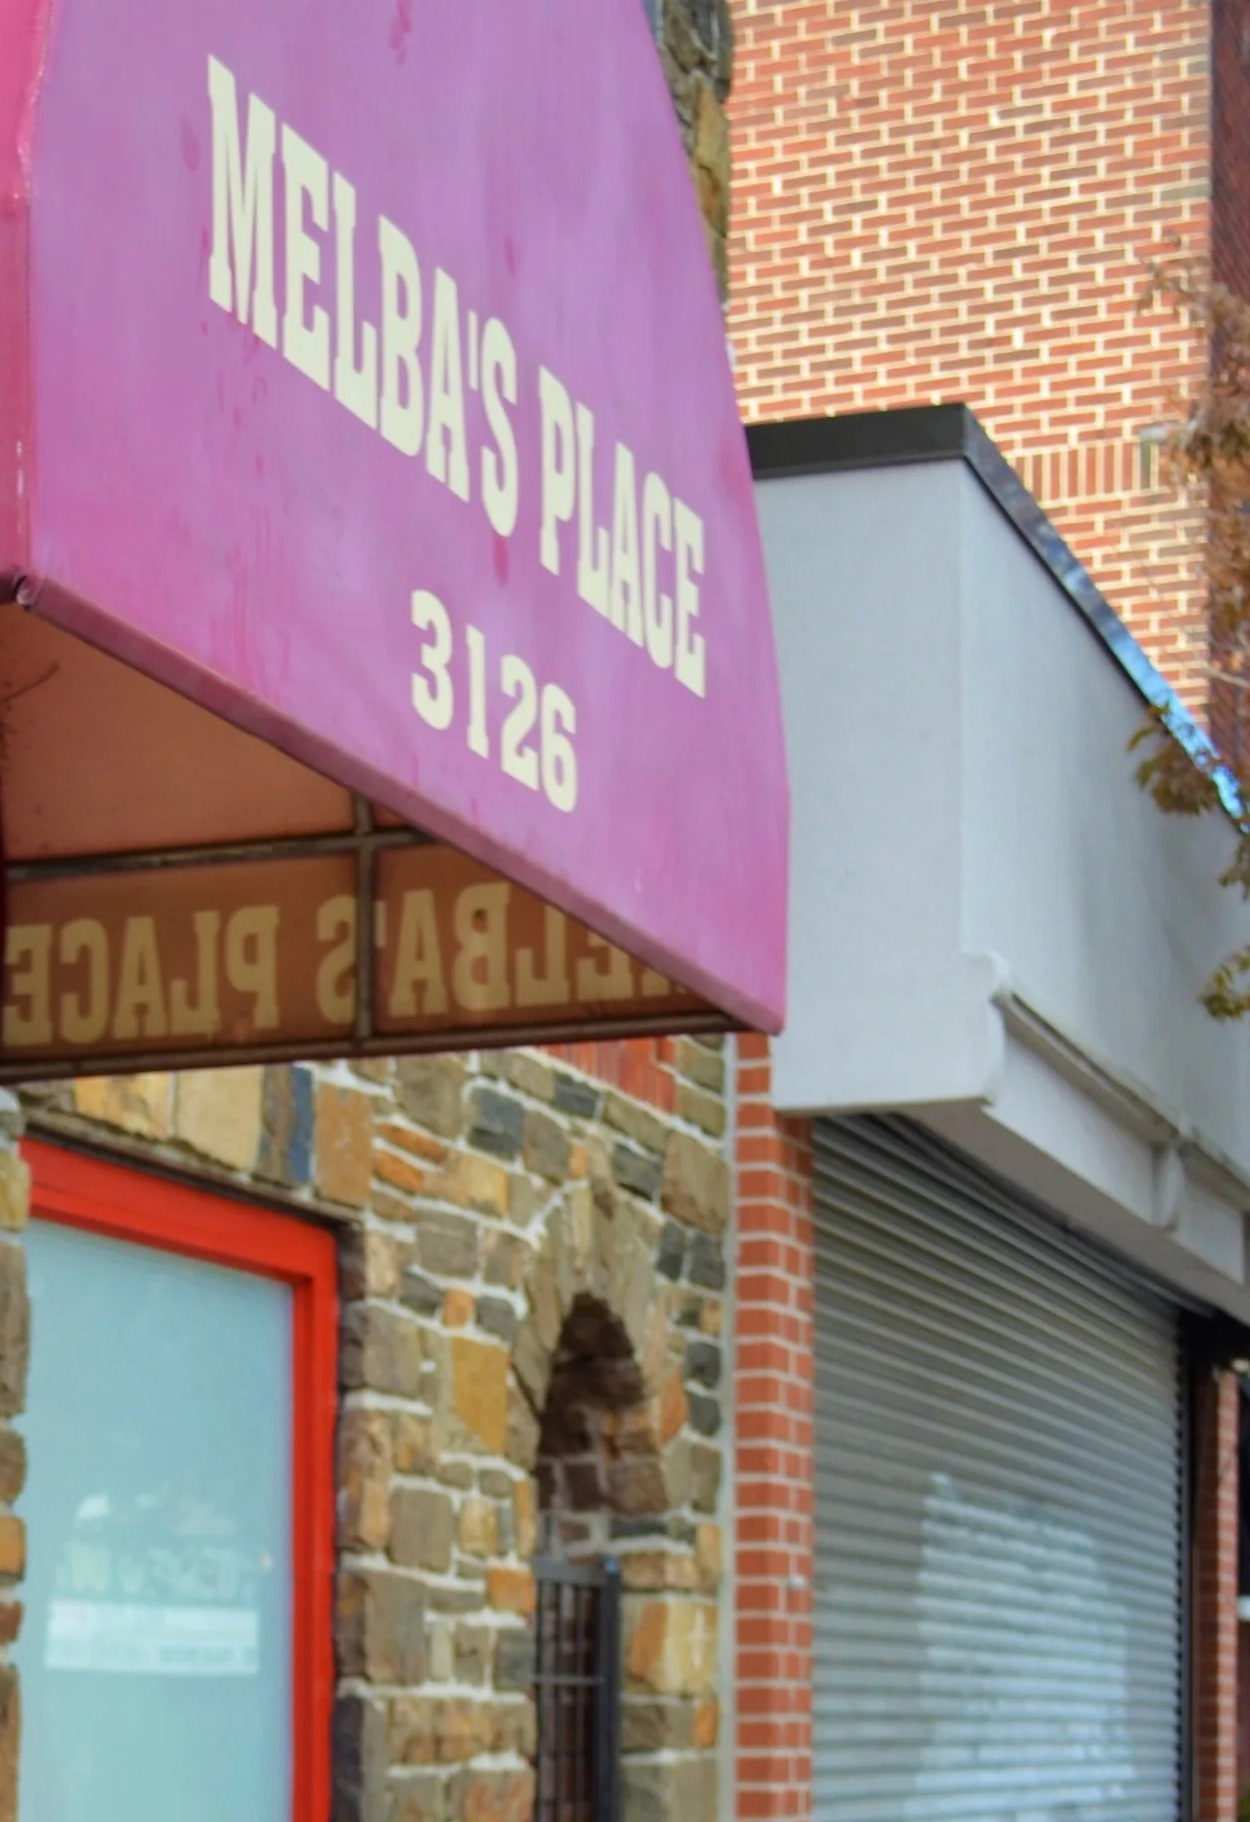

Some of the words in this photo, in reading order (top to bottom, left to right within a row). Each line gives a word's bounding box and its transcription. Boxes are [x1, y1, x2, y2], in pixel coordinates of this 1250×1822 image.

[208, 53, 518, 538] MELBA'S
[539, 364, 706, 700] PLACE
[410, 588, 578, 814] 3126
